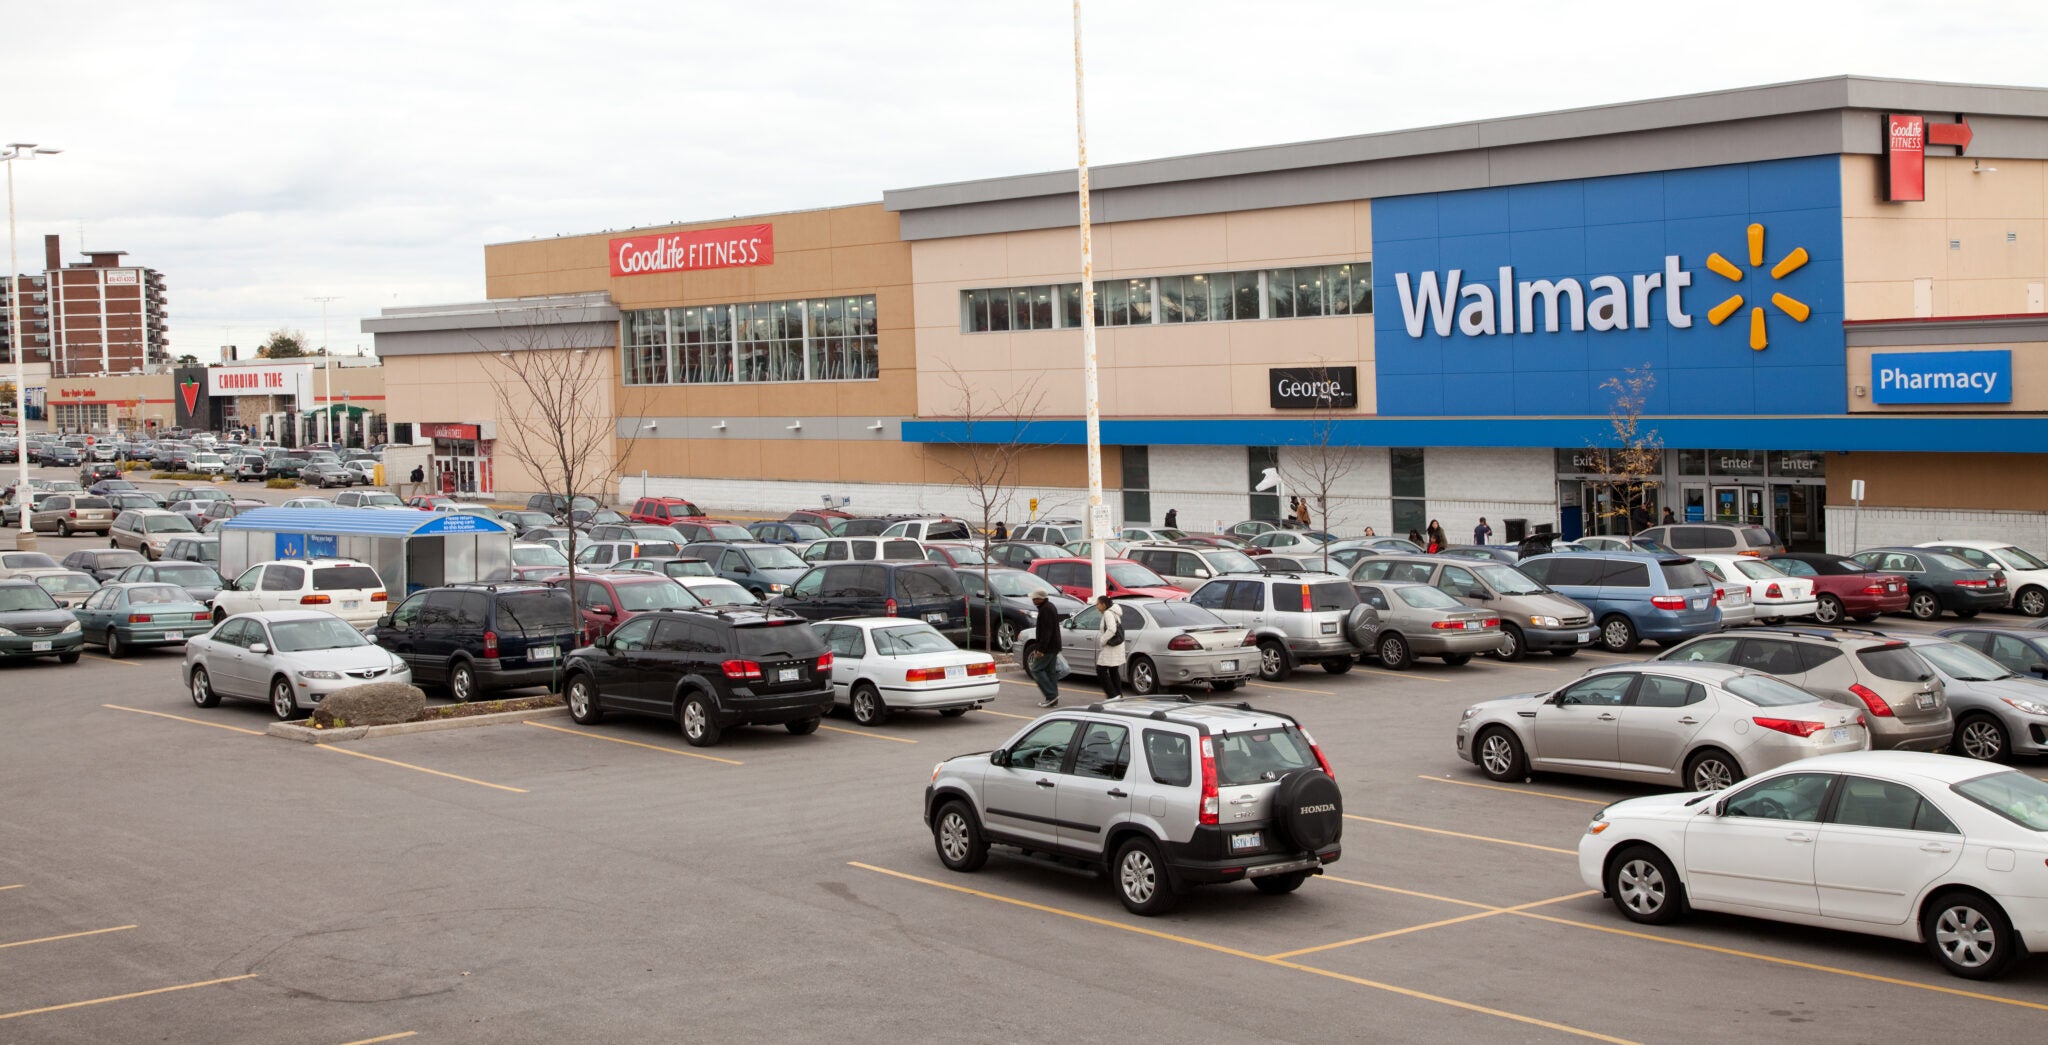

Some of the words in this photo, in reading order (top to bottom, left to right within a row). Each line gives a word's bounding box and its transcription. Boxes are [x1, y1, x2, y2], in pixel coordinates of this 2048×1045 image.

[1890, 121, 1922, 137] GoodLife
[1891, 137, 1921, 149] FITNESS
[619, 236, 685, 272] GoodLife
[689, 238, 759, 267] FITNESS
[1394, 255, 1692, 338] Walmart
[219, 373, 259, 389] CANADIAN
[264, 372, 283, 388] TIRE
[1880, 367, 1998, 394] Pharmacy
[1721, 456, 1753, 468] Enter
[1781, 457, 1815, 470] Enter
[1300, 803, 1336, 815] HONDA
